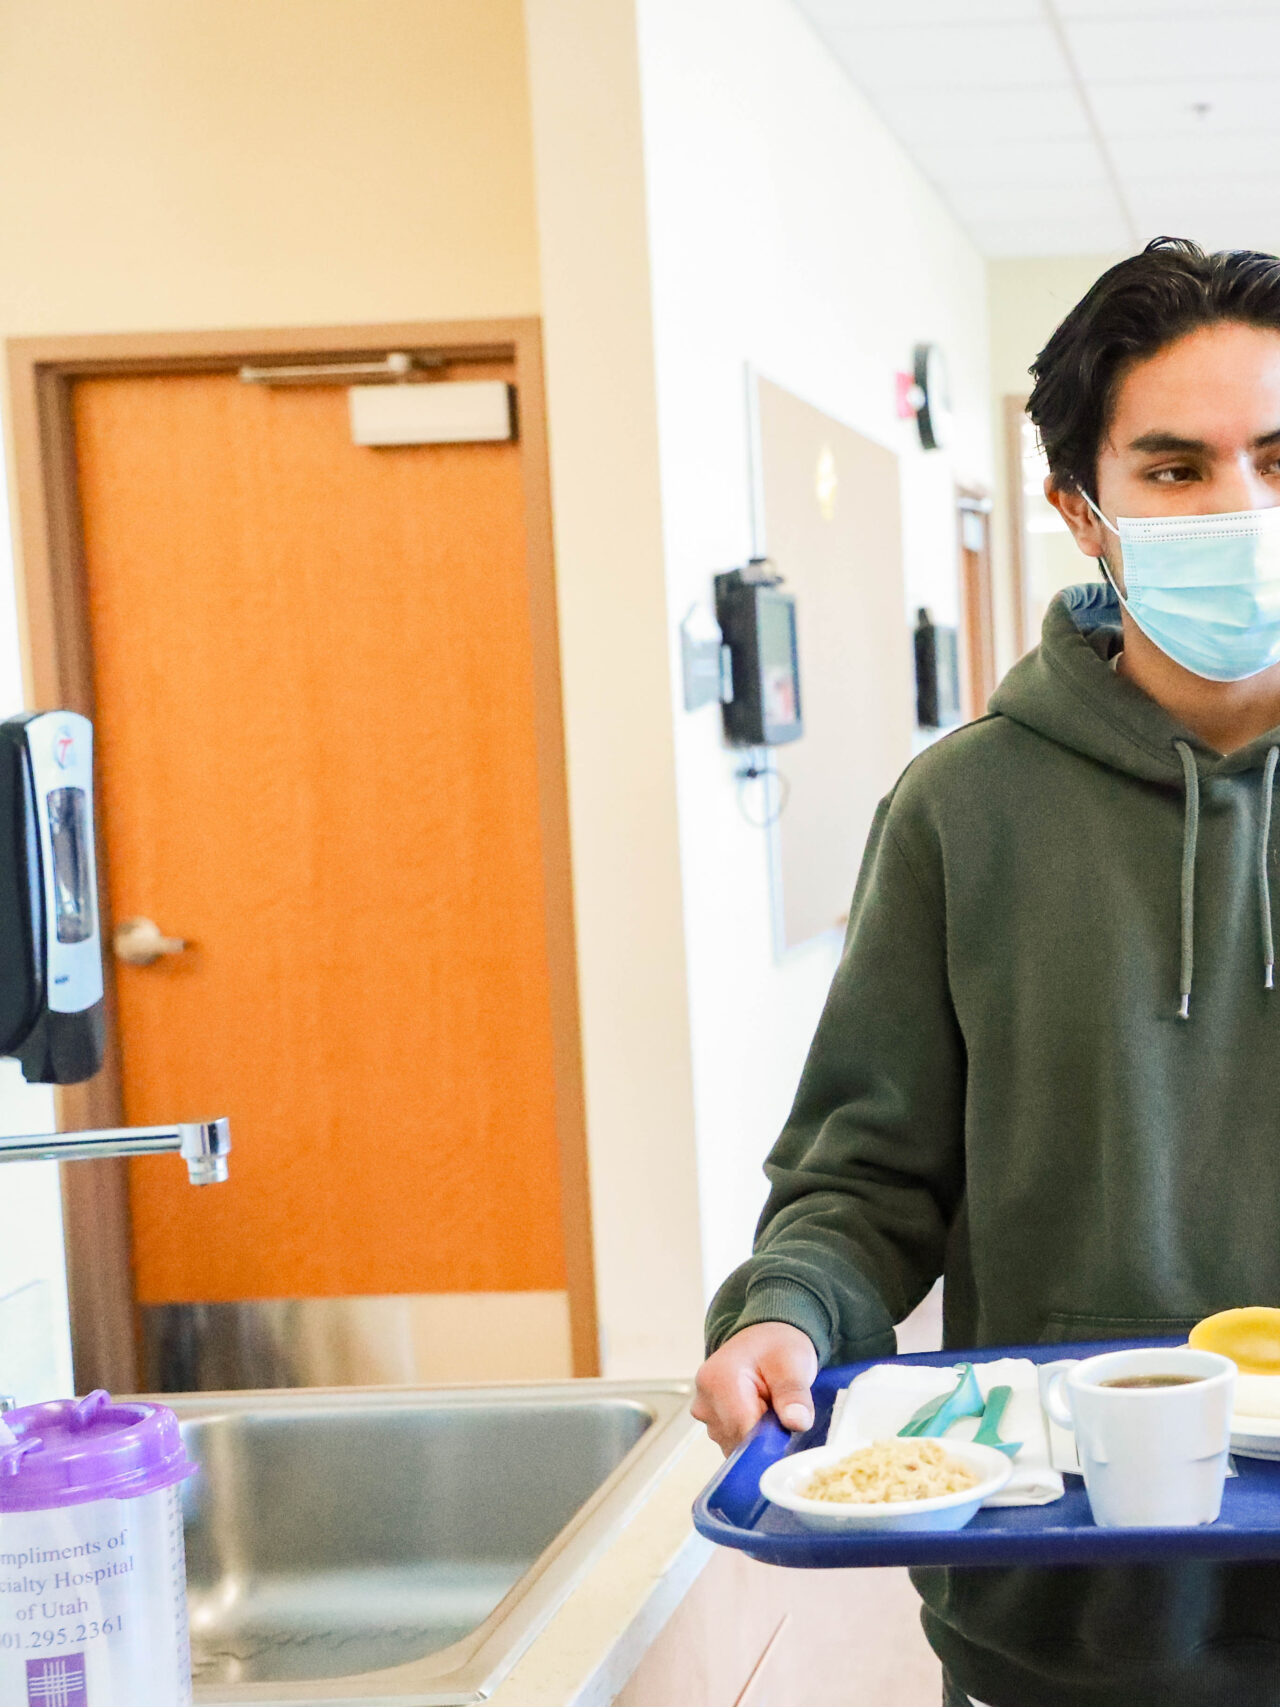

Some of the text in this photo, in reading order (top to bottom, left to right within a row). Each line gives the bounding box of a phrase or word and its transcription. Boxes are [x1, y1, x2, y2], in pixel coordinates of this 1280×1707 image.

[0, 1528, 128, 1569] mpliments of
[55, 1555, 134, 1588] Hospital
[16, 1597, 89, 1621] of Utah
[0, 1615, 122, 1648] 01.295.2361
